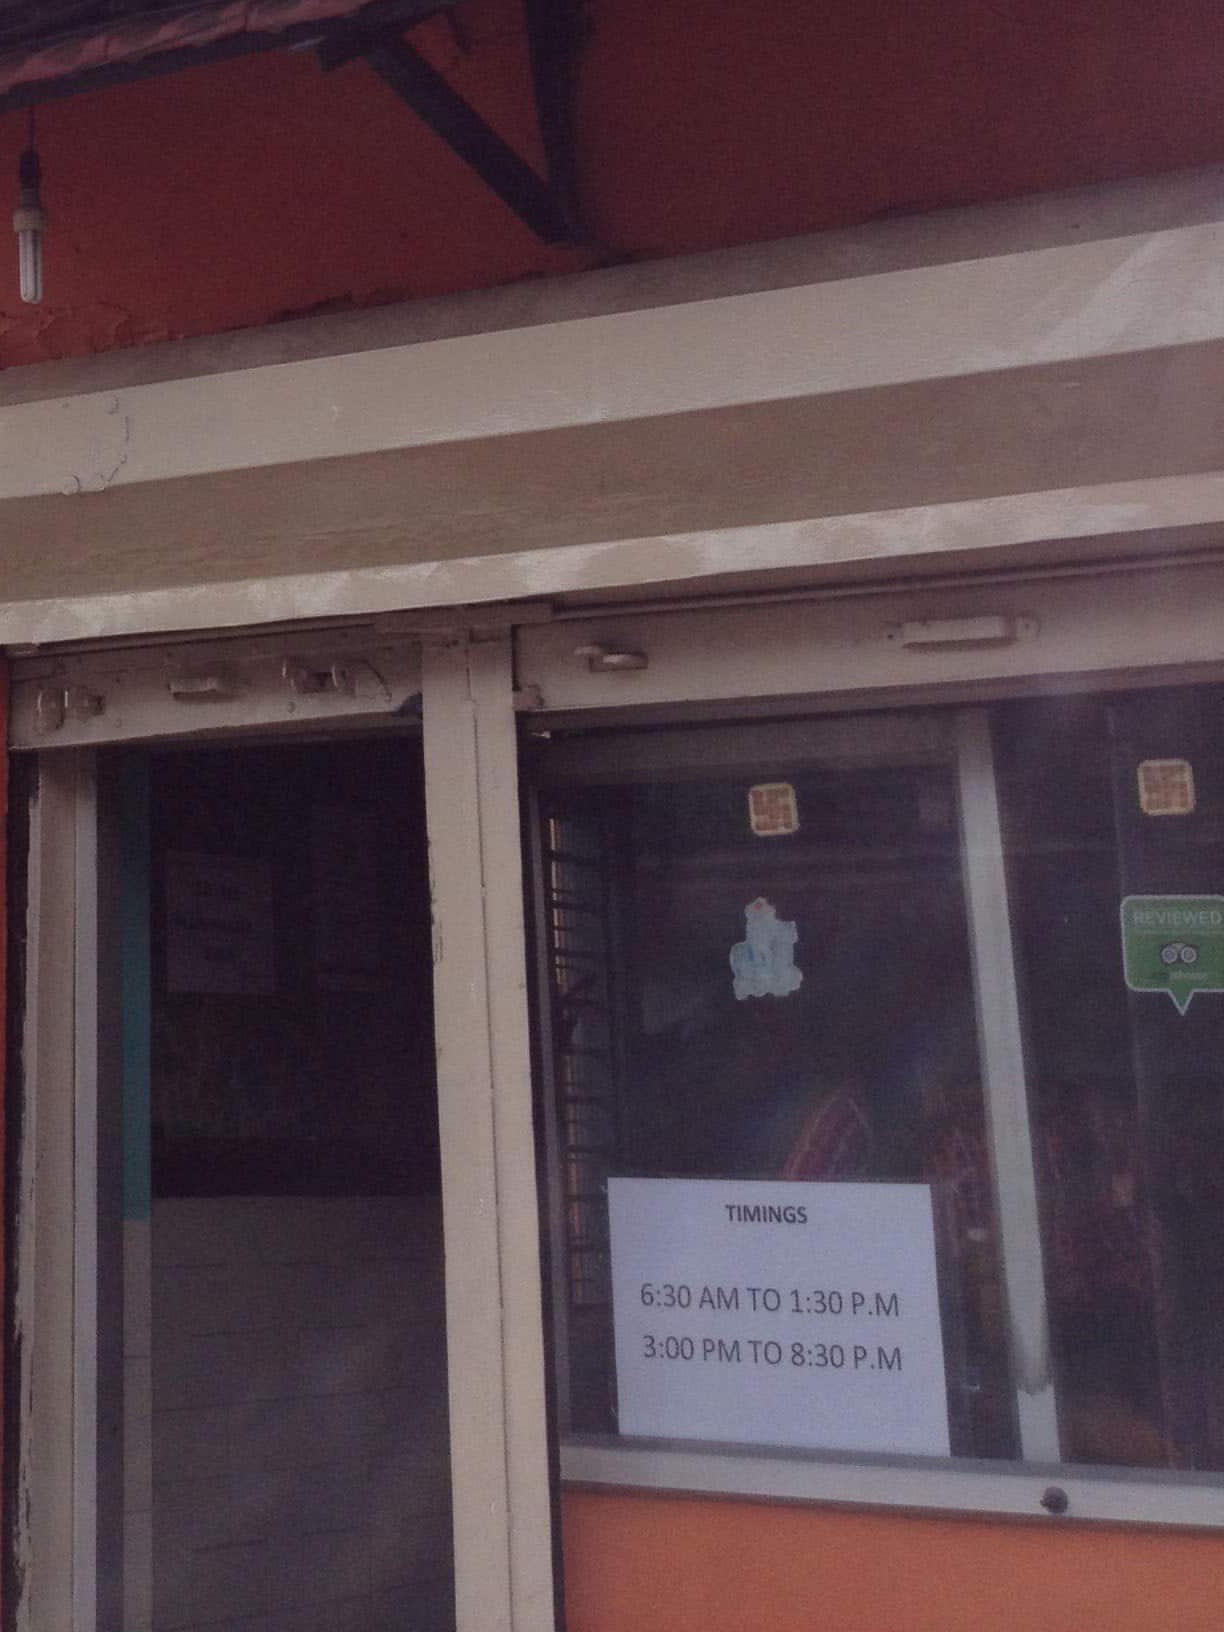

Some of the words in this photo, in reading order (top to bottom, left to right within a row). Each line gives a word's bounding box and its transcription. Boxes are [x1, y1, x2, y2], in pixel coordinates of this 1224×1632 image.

[1132, 910, 1223, 926] REVIEWED
[726, 1204, 808, 1224] TIMINGS
[640, 1283, 691, 1309] 6:30
[698, 1286, 739, 1311] AM
[747, 1288, 781, 1312] TO
[790, 1289, 843, 1315] 1:30
[851, 1291, 900, 1317] P.M
[643, 1335, 694, 1361] 3:00
[703, 1338, 741, 1364] PM
[747, 1340, 782, 1365] TO
[791, 1342, 844, 1369] 8:30
[853, 1345, 902, 1371] P.M
